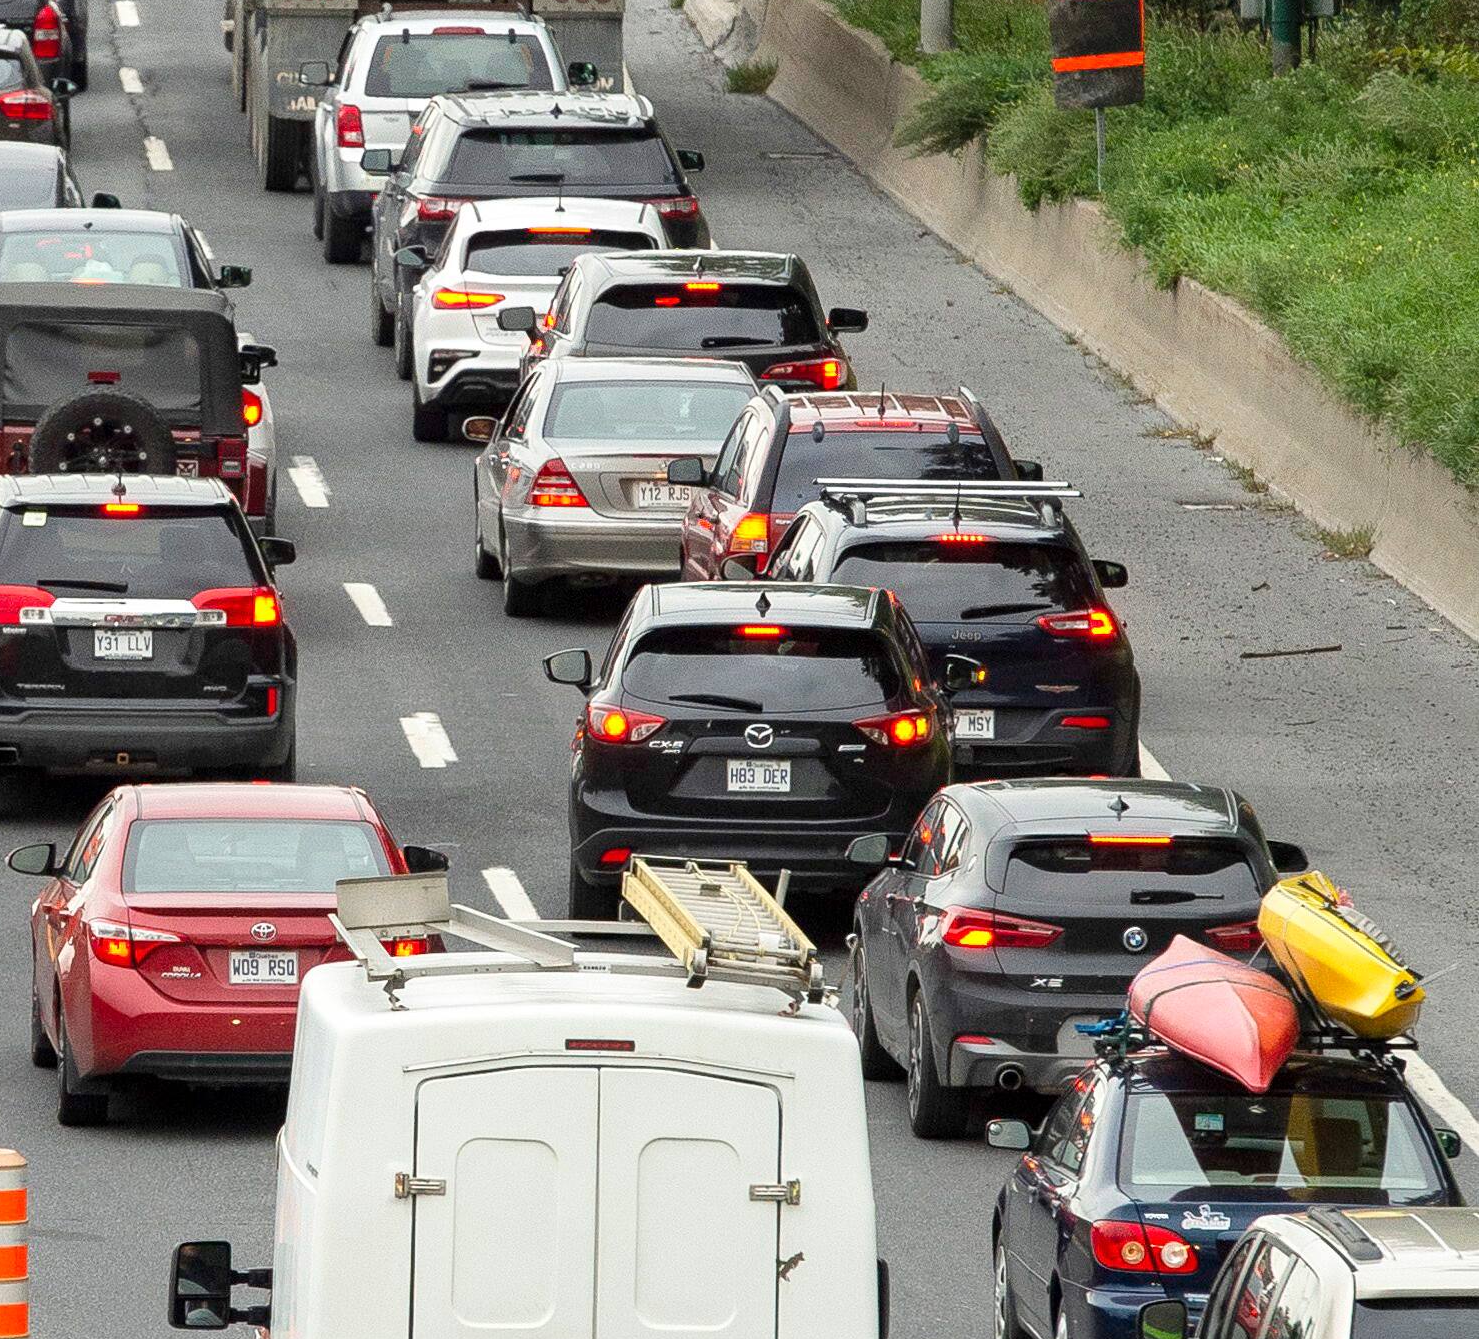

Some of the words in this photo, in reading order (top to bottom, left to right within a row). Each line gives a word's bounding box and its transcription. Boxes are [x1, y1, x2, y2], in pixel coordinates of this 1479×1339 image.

[640, 486, 662, 501] Y12
[668, 486, 690, 501] RJS
[951, 629, 982, 642] Jeep
[97, 636, 119, 652] Y31
[127, 636, 151, 652] LLV
[968, 716, 992, 732] MSY
[730, 768, 755, 784] H83
[763, 768, 789, 785] DER
[233, 959, 259, 976] W09
[268, 959, 295, 976] RSQ
